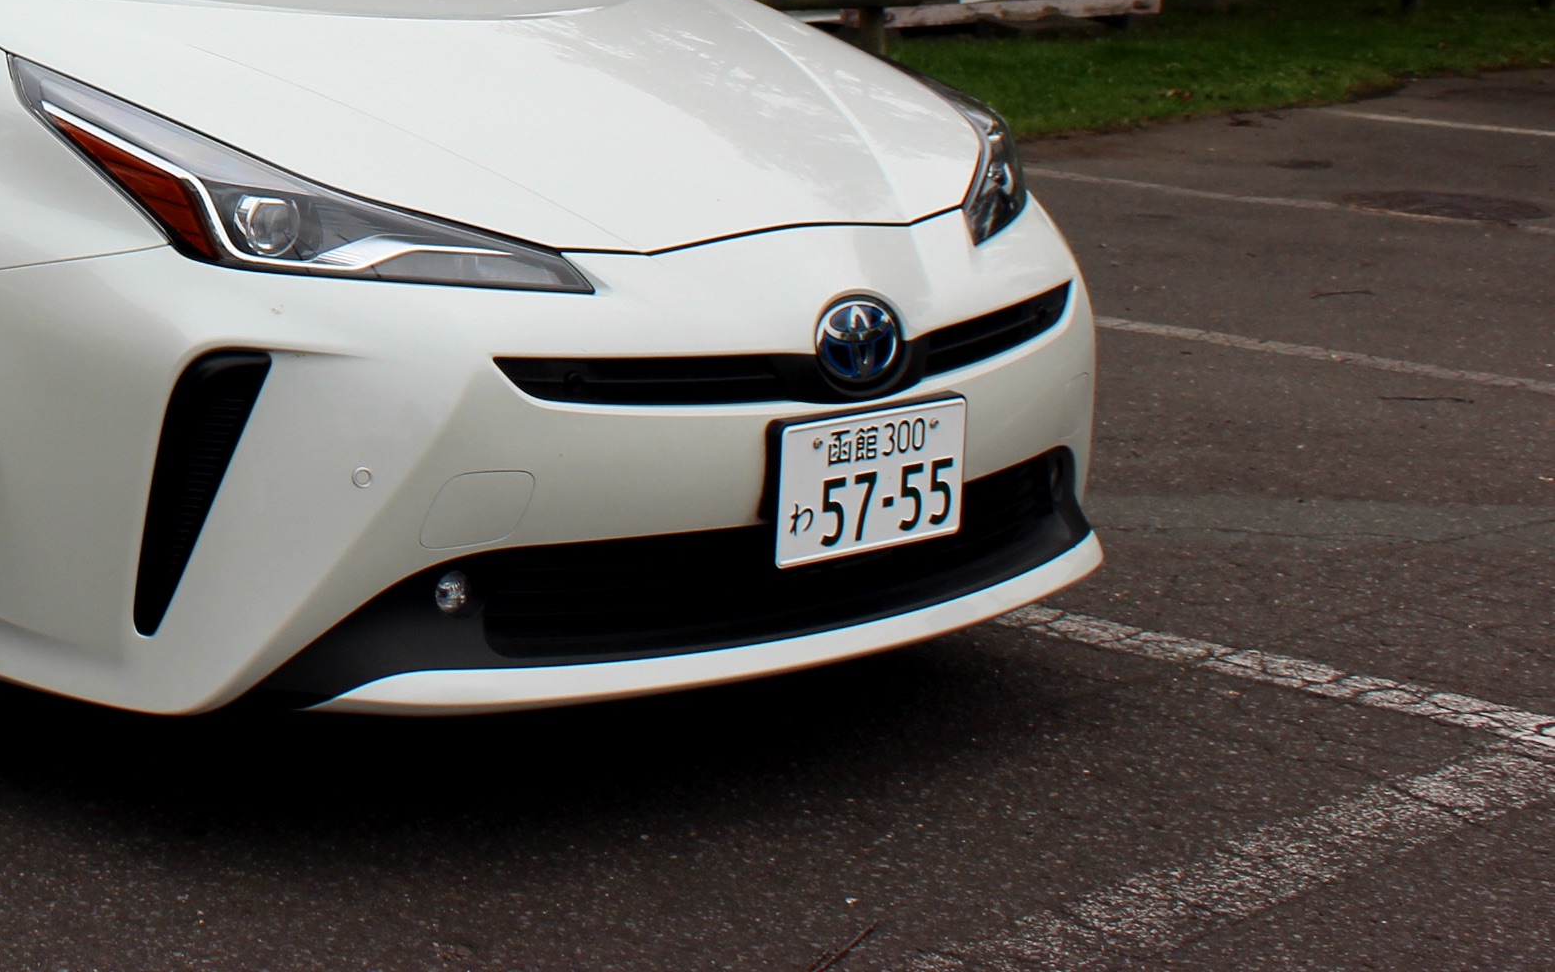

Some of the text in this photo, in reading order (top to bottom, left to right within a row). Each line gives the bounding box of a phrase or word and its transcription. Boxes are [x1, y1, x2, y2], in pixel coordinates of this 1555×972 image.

[827, 417, 926, 467] 函館300
[789, 457, 954, 547] わ 57-55
